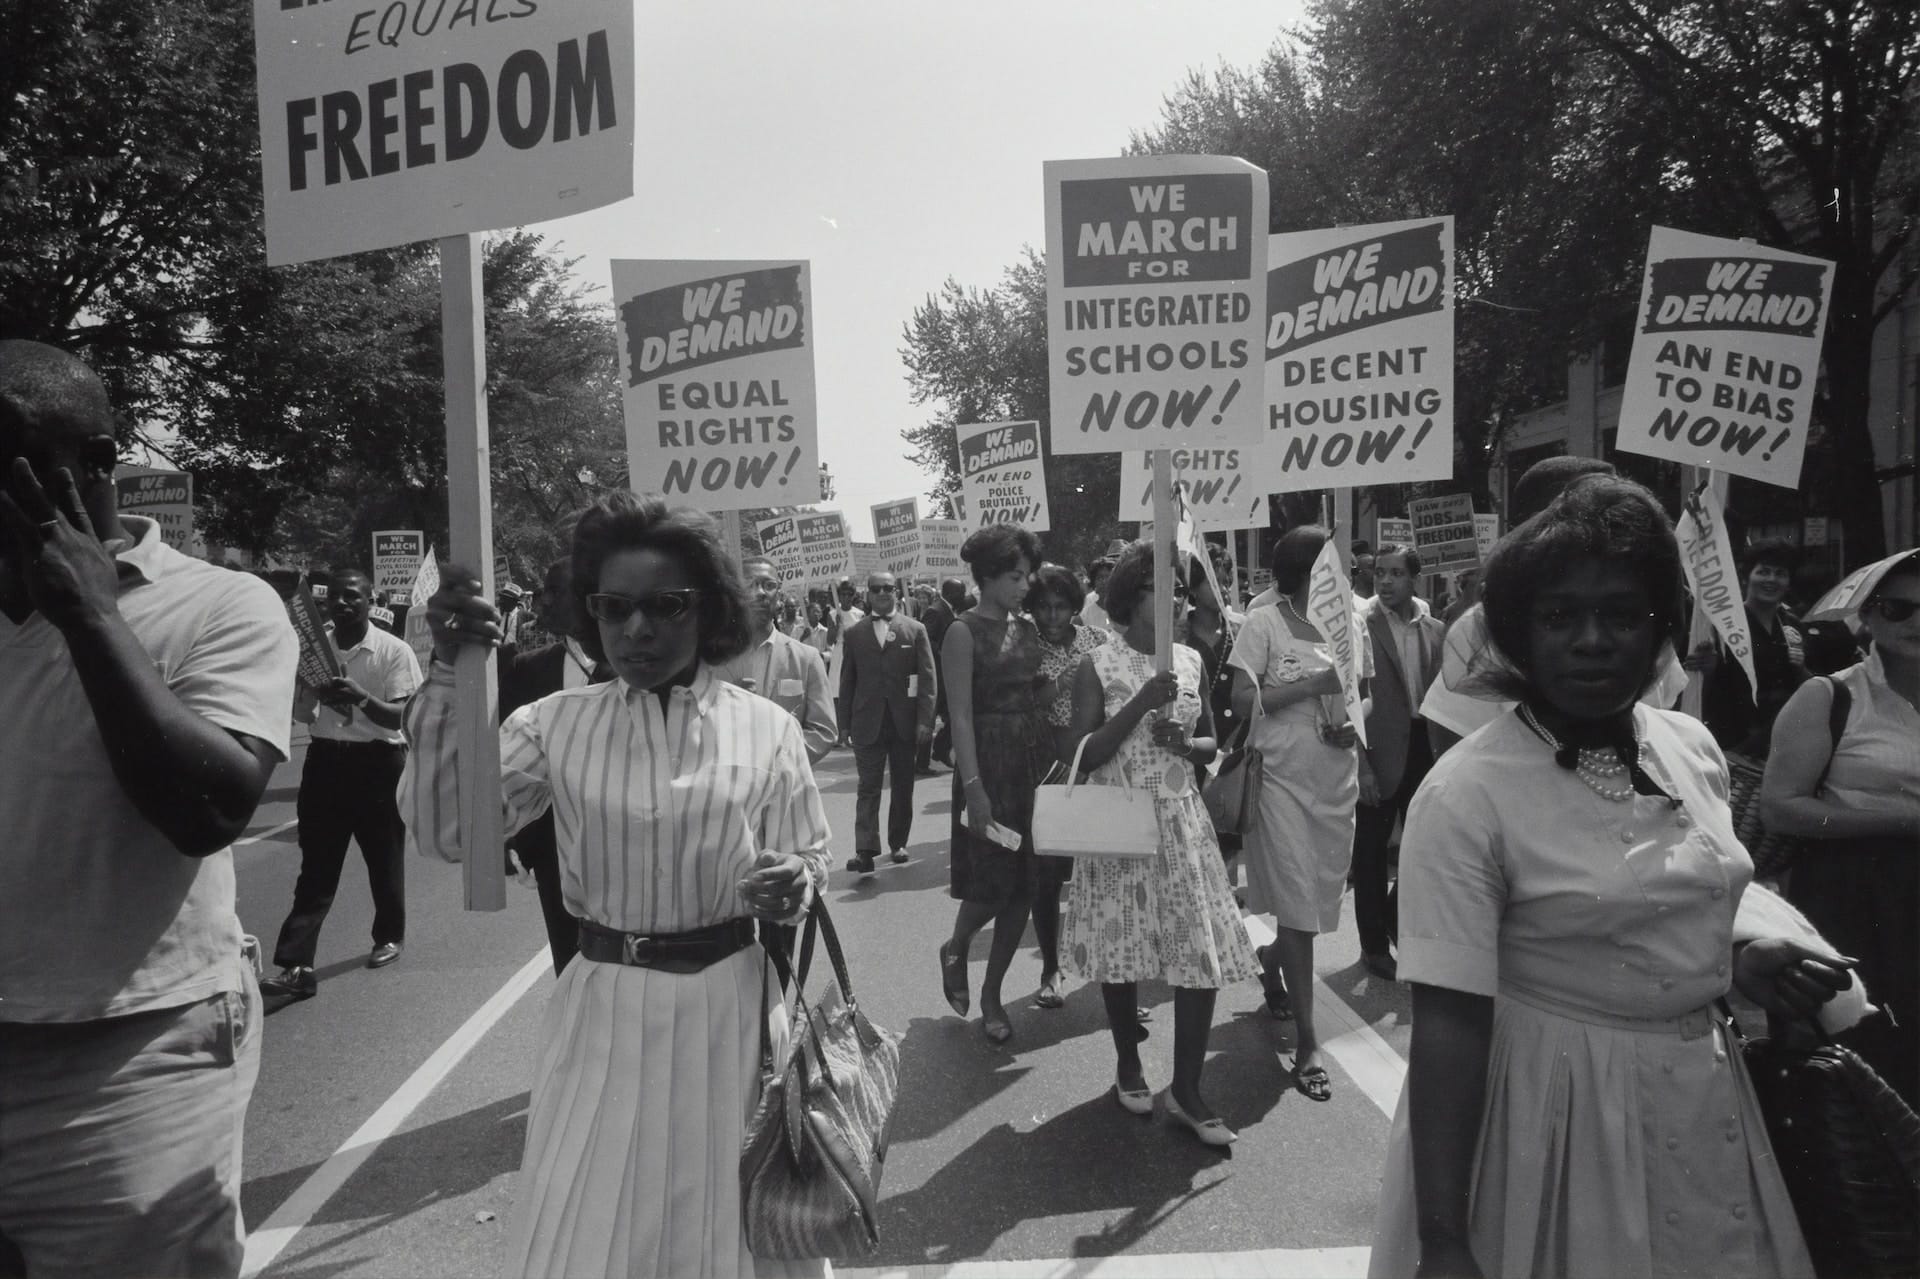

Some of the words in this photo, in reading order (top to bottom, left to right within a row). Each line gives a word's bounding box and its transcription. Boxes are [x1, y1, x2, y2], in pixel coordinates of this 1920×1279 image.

[286, 29, 617, 192] FREEDOM
[1129, 184, 1185, 213] WE
[1077, 216, 1238, 257] MARCH
[1128, 259, 1190, 278] FOR
[1313, 242, 1383, 294] WE
[1706, 261, 1773, 291] WE
[682, 279, 745, 322] WE
[1266, 266, 1438, 349] DEMAND
[1655, 293, 1815, 326] DEMAND
[1064, 292, 1251, 331] INTEGRATED
[640, 305, 798, 372] DEMAND
[1065, 339, 1249, 377] SCHOOLS
[1283, 346, 1427, 387] DECENT
[1655, 339, 1712, 372] AN
[1724, 351, 1803, 390] END
[658, 380, 788, 411] EQUAL
[1080, 378, 1241, 433] NOW!
[1655, 372, 1702, 403] TO
[1712, 383, 1795, 424] BIAS
[1269, 388, 1441, 430] HOUSING
[658, 415, 795, 448] RIGHTS
[986, 428, 1013, 448] WE
[1649, 407, 1791, 462] NOW!
[1281, 417, 1433, 472] NOW!
[968, 439, 1035, 472] DEMAND
[1144, 450, 1239, 470] RGHTS
[662, 446, 801, 495] NOW!
[976, 473, 998, 484] AN
[1003, 471, 1032, 481] END
[140, 476, 167, 489] WE
[989, 486, 1024, 497] POLICE
[122, 488, 186, 506] DEMAND
[980, 496, 1031, 508] BRUTALITY
[1415, 502, 1439, 512] UAW
[880, 513, 913, 529] MARCH
[889, 507, 900, 516] WE
[980, 502, 1041, 526] NOW!
[1416, 511, 1453, 528] JOBS
[774, 520, 791, 535] WE
[802, 524, 840, 537] MARCH
[812, 518, 826, 526] WE
[765, 531, 796, 550] DEMA
[879, 538, 898, 549] FIRST
[900, 533, 919, 544] CLASS
[1416, 525, 1473, 546] FREEDOM
[380, 542, 417, 550] MARCH
[770, 549, 784, 557] AN
[787, 546, 799, 554] EN
[802, 540, 847, 554] INTEGRATED
[879, 542, 921, 559] CITIZENSHIP
[804, 550, 849, 564] SCHOOLS
[888, 554, 920, 573] NOW!
[926, 557, 958, 567] REEDOM
[811, 560, 849, 577] NOW!
[292, 593, 314, 635] MARCH
[1310, 563, 1351, 668] FREEDOM
[1722, 616, 1734, 630] IN
